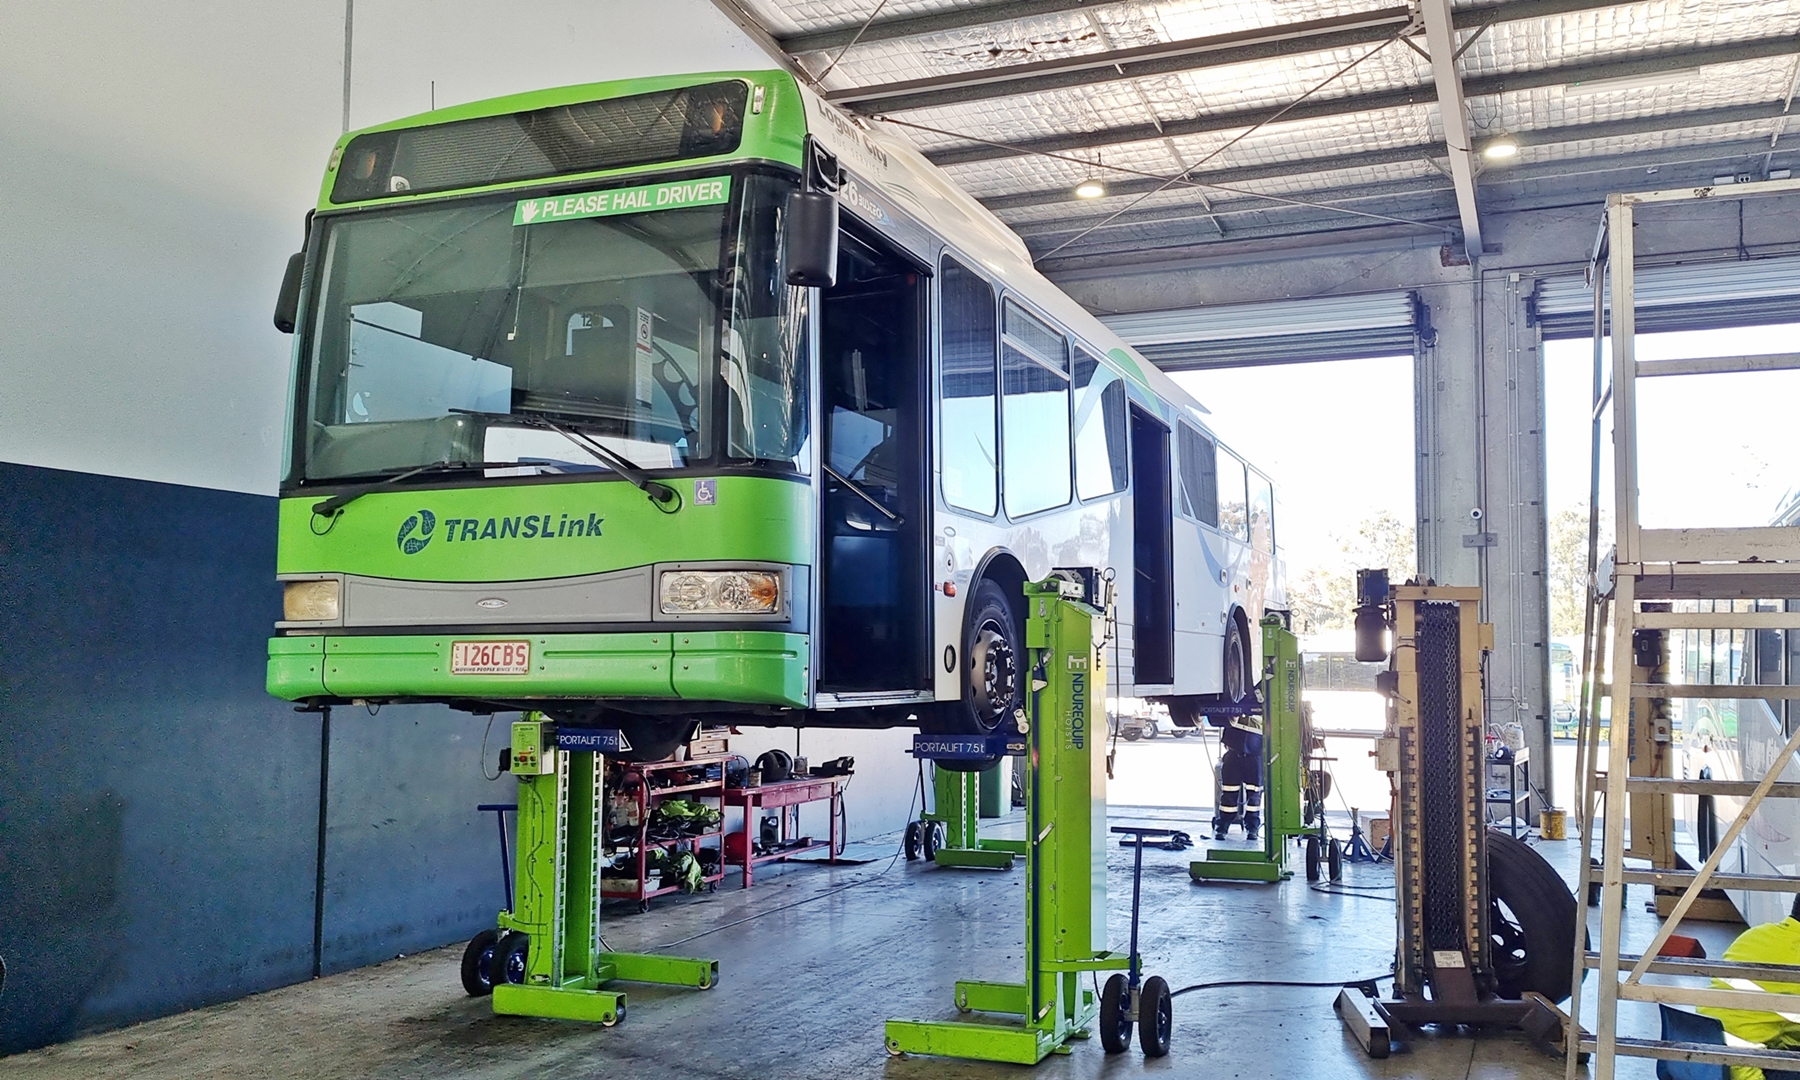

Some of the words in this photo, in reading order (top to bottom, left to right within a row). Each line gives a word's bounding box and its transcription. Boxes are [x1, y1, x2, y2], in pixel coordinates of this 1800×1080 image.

[816, 97, 860, 145] Logan
[862, 134, 888, 170] City
[542, 194, 609, 218] PLEASE
[612, 190, 652, 210] HAIL
[656, 181, 723, 206] DRIVER
[444, 513, 605, 543] TRANSLink
[463, 645, 526, 666] 126CBS
[1200, 706, 1230, 714] PORTALIFT
[560, 735, 600, 745] PORTALIFT
[914, 742, 964, 753] PORTALIFT
